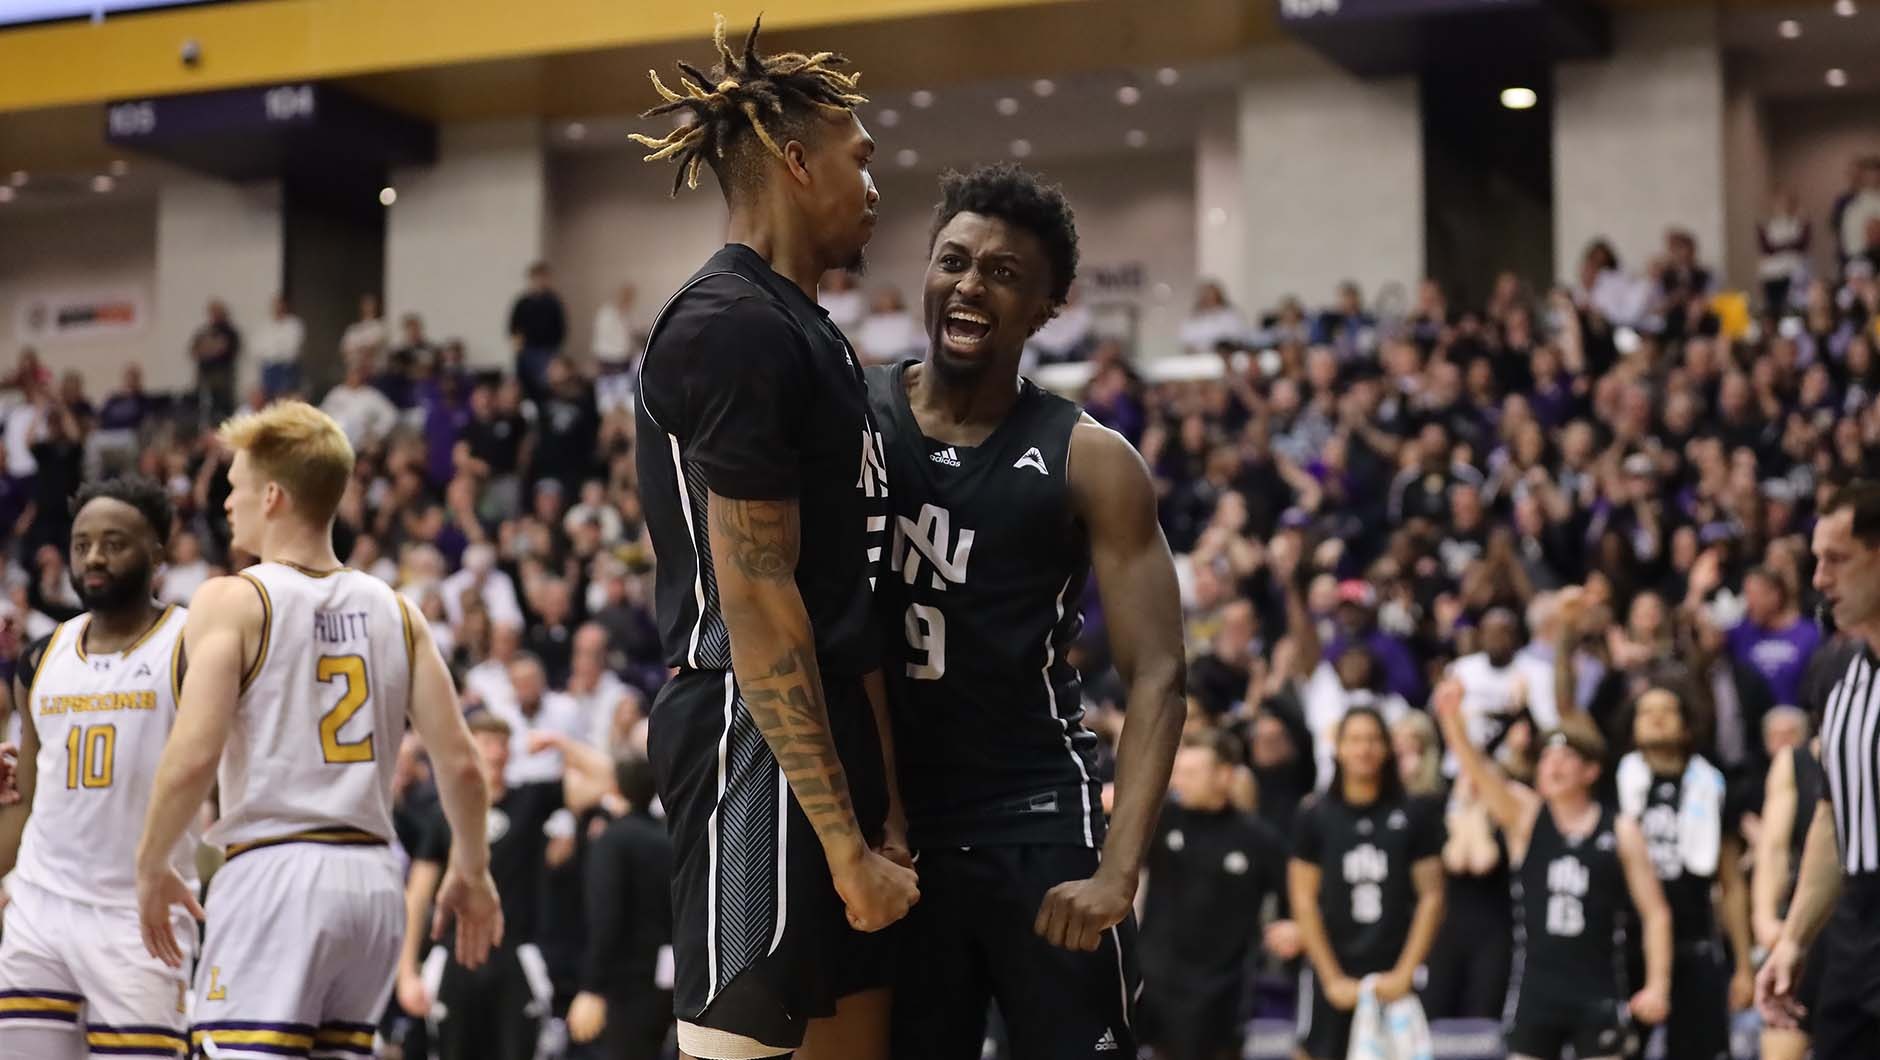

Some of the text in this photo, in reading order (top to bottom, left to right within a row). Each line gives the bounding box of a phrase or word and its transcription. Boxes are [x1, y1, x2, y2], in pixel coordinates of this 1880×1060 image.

[930, 454, 961, 468] adidas
[905, 602, 946, 681] 9
[39, 689, 157, 716] LIPSCOMB
[316, 654, 375, 764] 2
[65, 723, 117, 790] 10
[206, 966, 226, 1001] L
